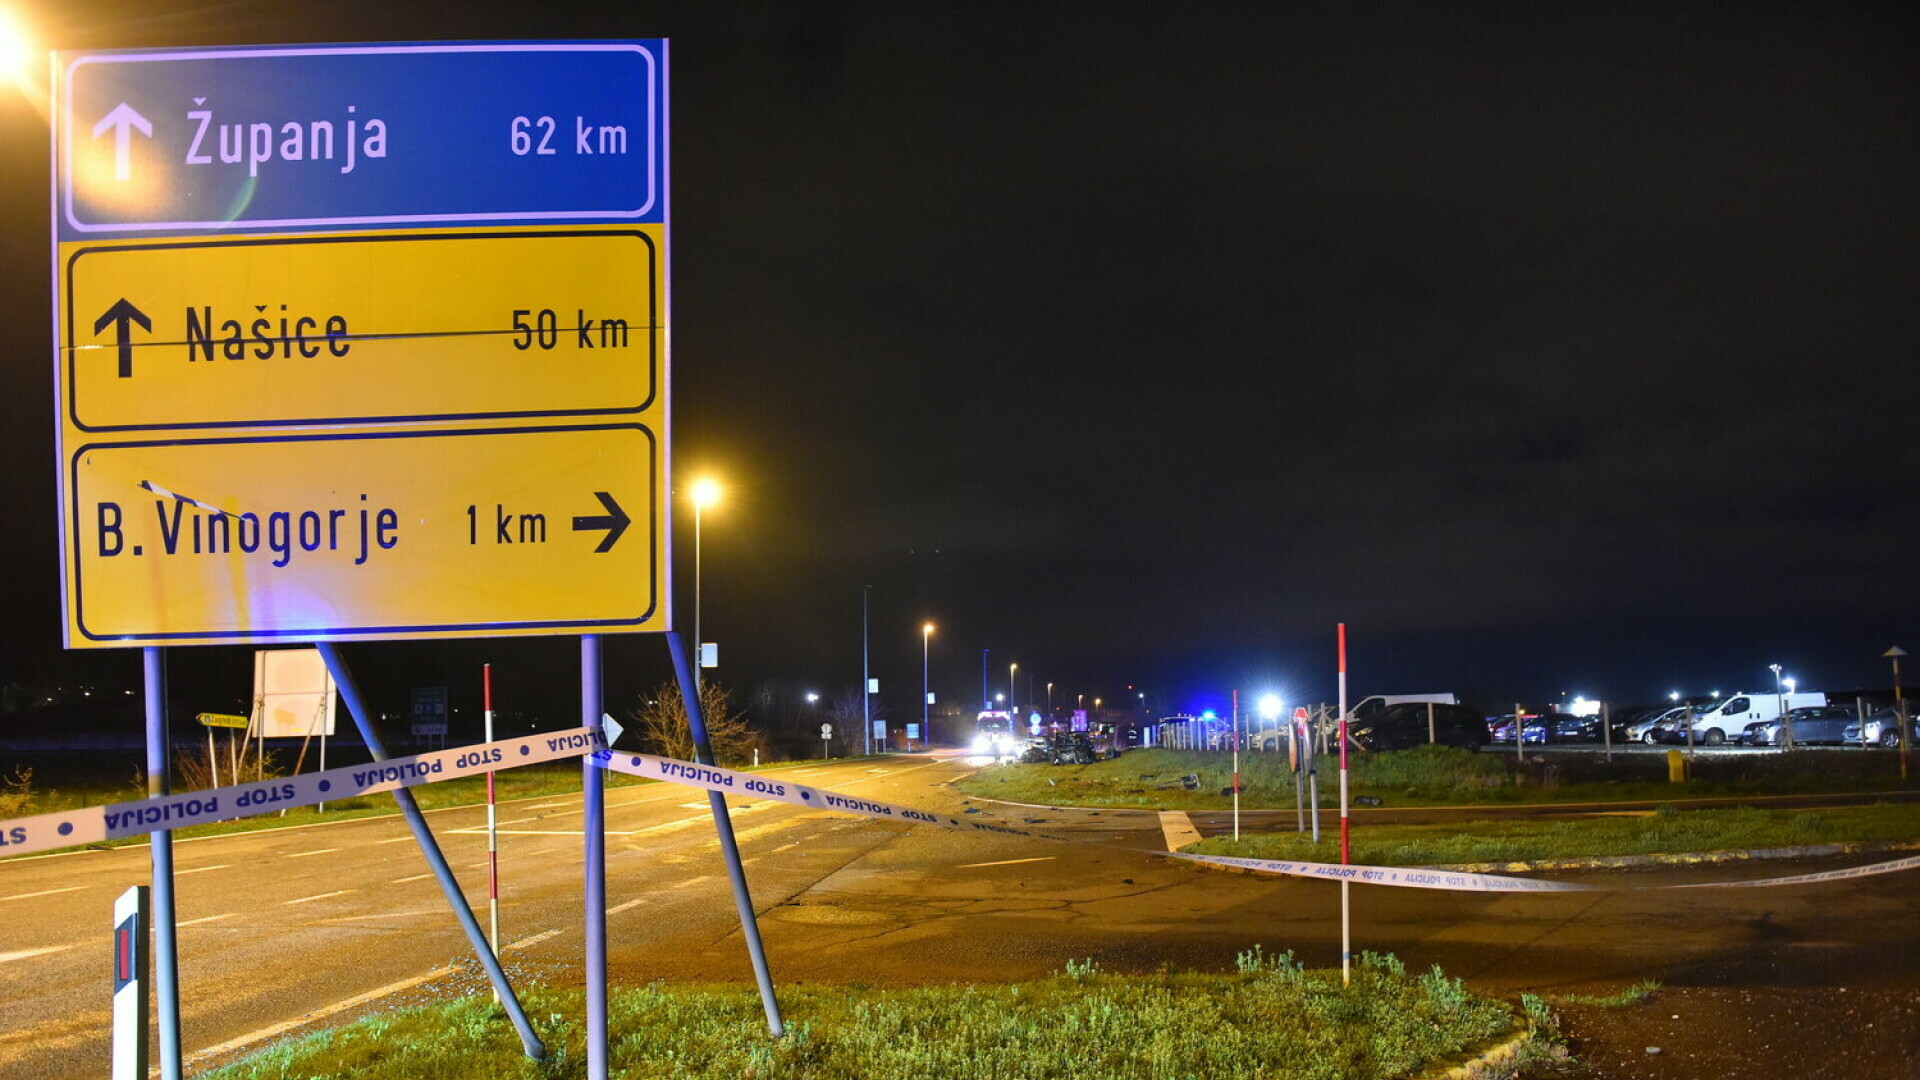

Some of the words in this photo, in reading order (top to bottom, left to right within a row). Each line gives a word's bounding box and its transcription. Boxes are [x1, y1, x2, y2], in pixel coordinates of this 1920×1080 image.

[185, 96, 387, 177] Županja
[511, 115, 556, 156] 62
[576, 115, 627, 155] km
[186, 305, 350, 362] Našice
[512, 309, 557, 350] 50
[577, 309, 628, 349] km
[97, 502, 143, 557] B.
[154, 493, 398, 568] Vinogorje
[467, 504, 476, 545] 1
[497, 503, 547, 544] km
[547, 732, 608, 752] OLICIJA
[456, 748, 502, 769] STOP
[353, 759, 442, 787] POLICIJA
[660, 761, 733, 786] POLICIJA
[236, 784, 295, 807] STOP
[744, 780, 785, 796] STOP
[104, 797, 218, 830] POLICIJA
[826, 795, 891, 815] POLICIJA
[901, 810, 938, 823] STOP
